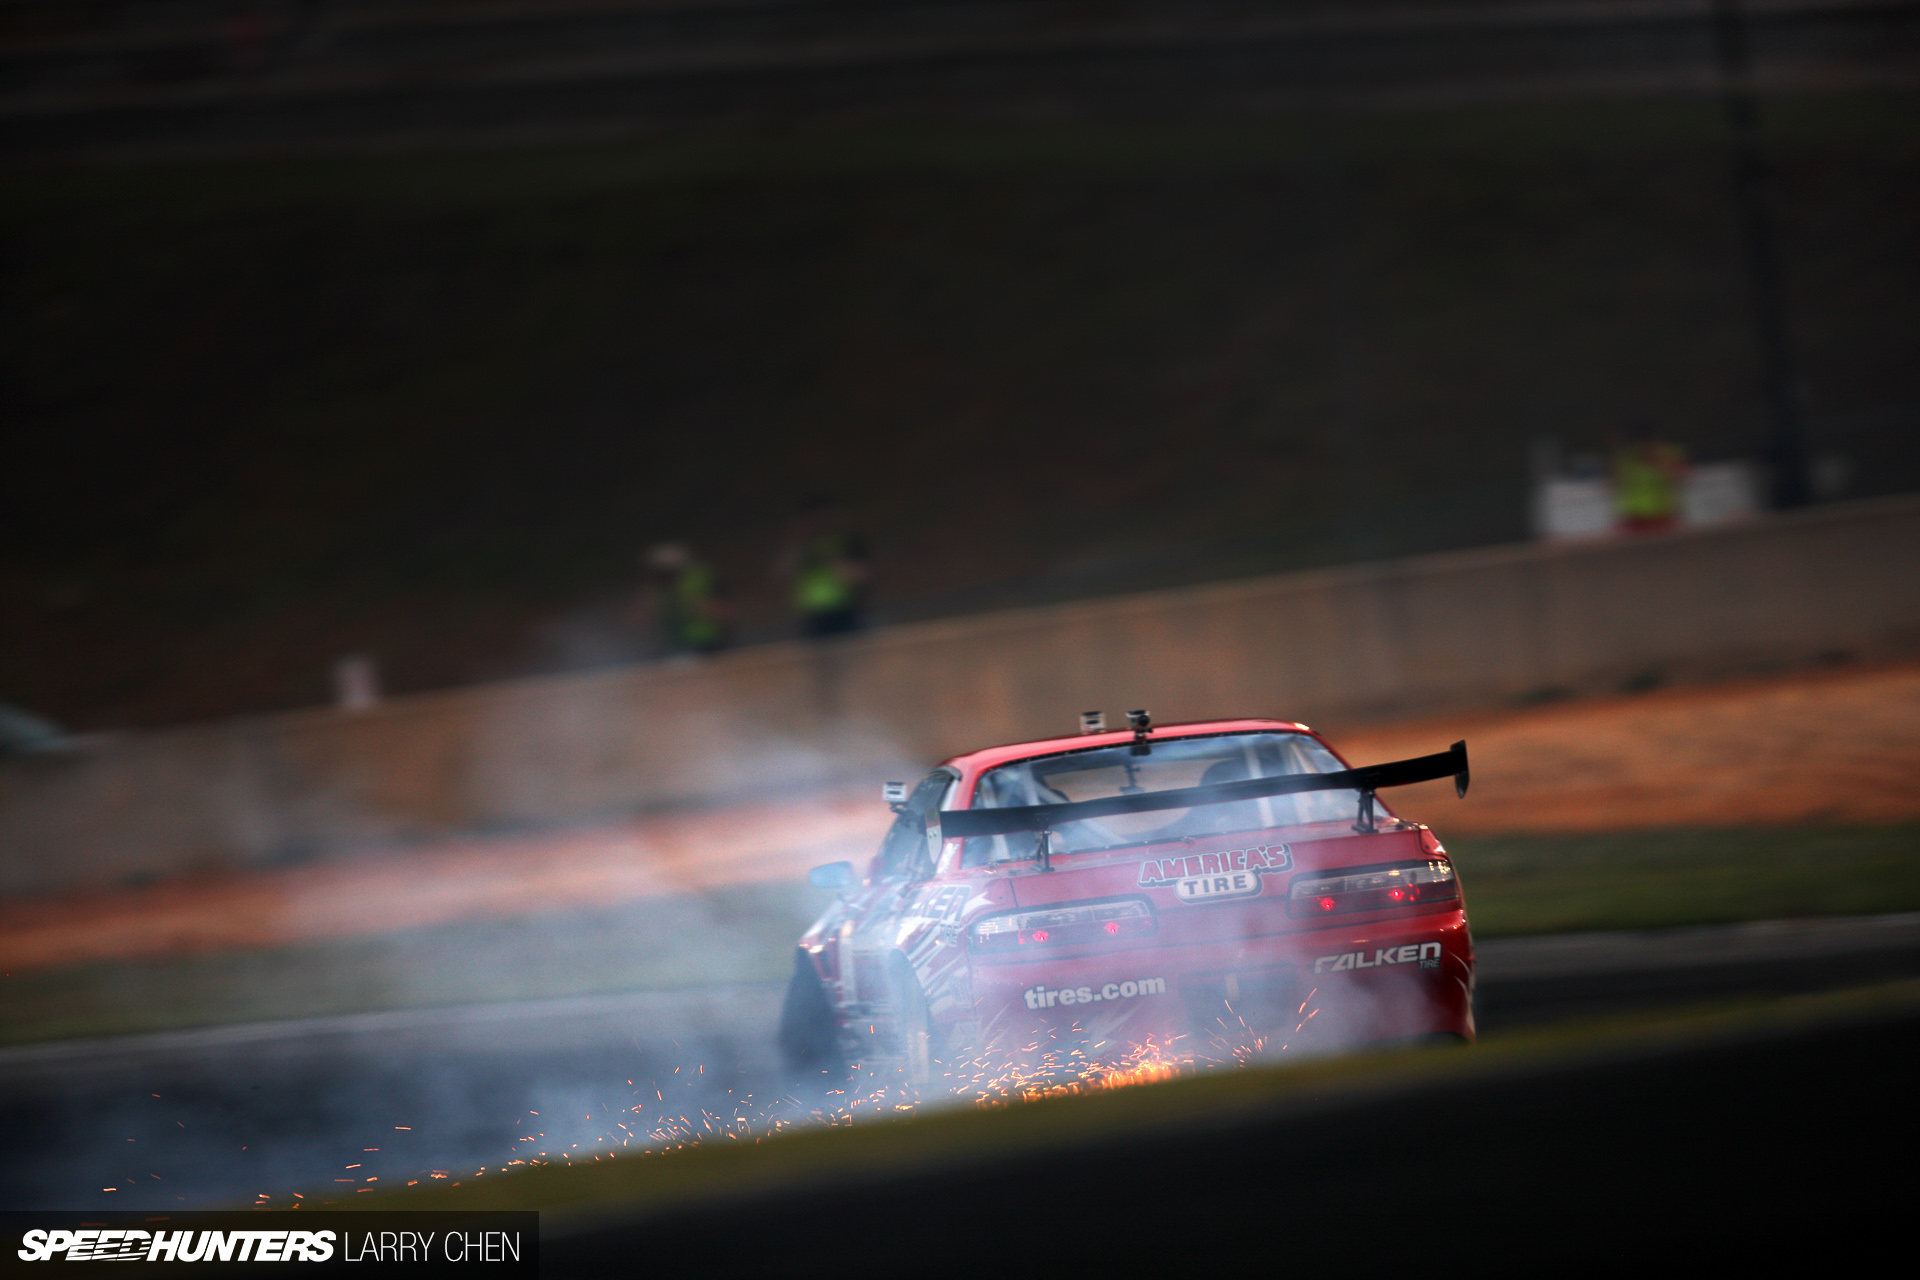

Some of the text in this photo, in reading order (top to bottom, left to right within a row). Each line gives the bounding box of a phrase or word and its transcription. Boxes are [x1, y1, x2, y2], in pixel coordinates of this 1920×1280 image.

[1139, 845, 1288, 884] AMERICA'S
[1184, 874, 1247, 896] TIRE
[1313, 941, 1442, 974] FALKEN
[1418, 958, 1441, 970] TIRE
[1023, 976, 1167, 1010] tires.com
